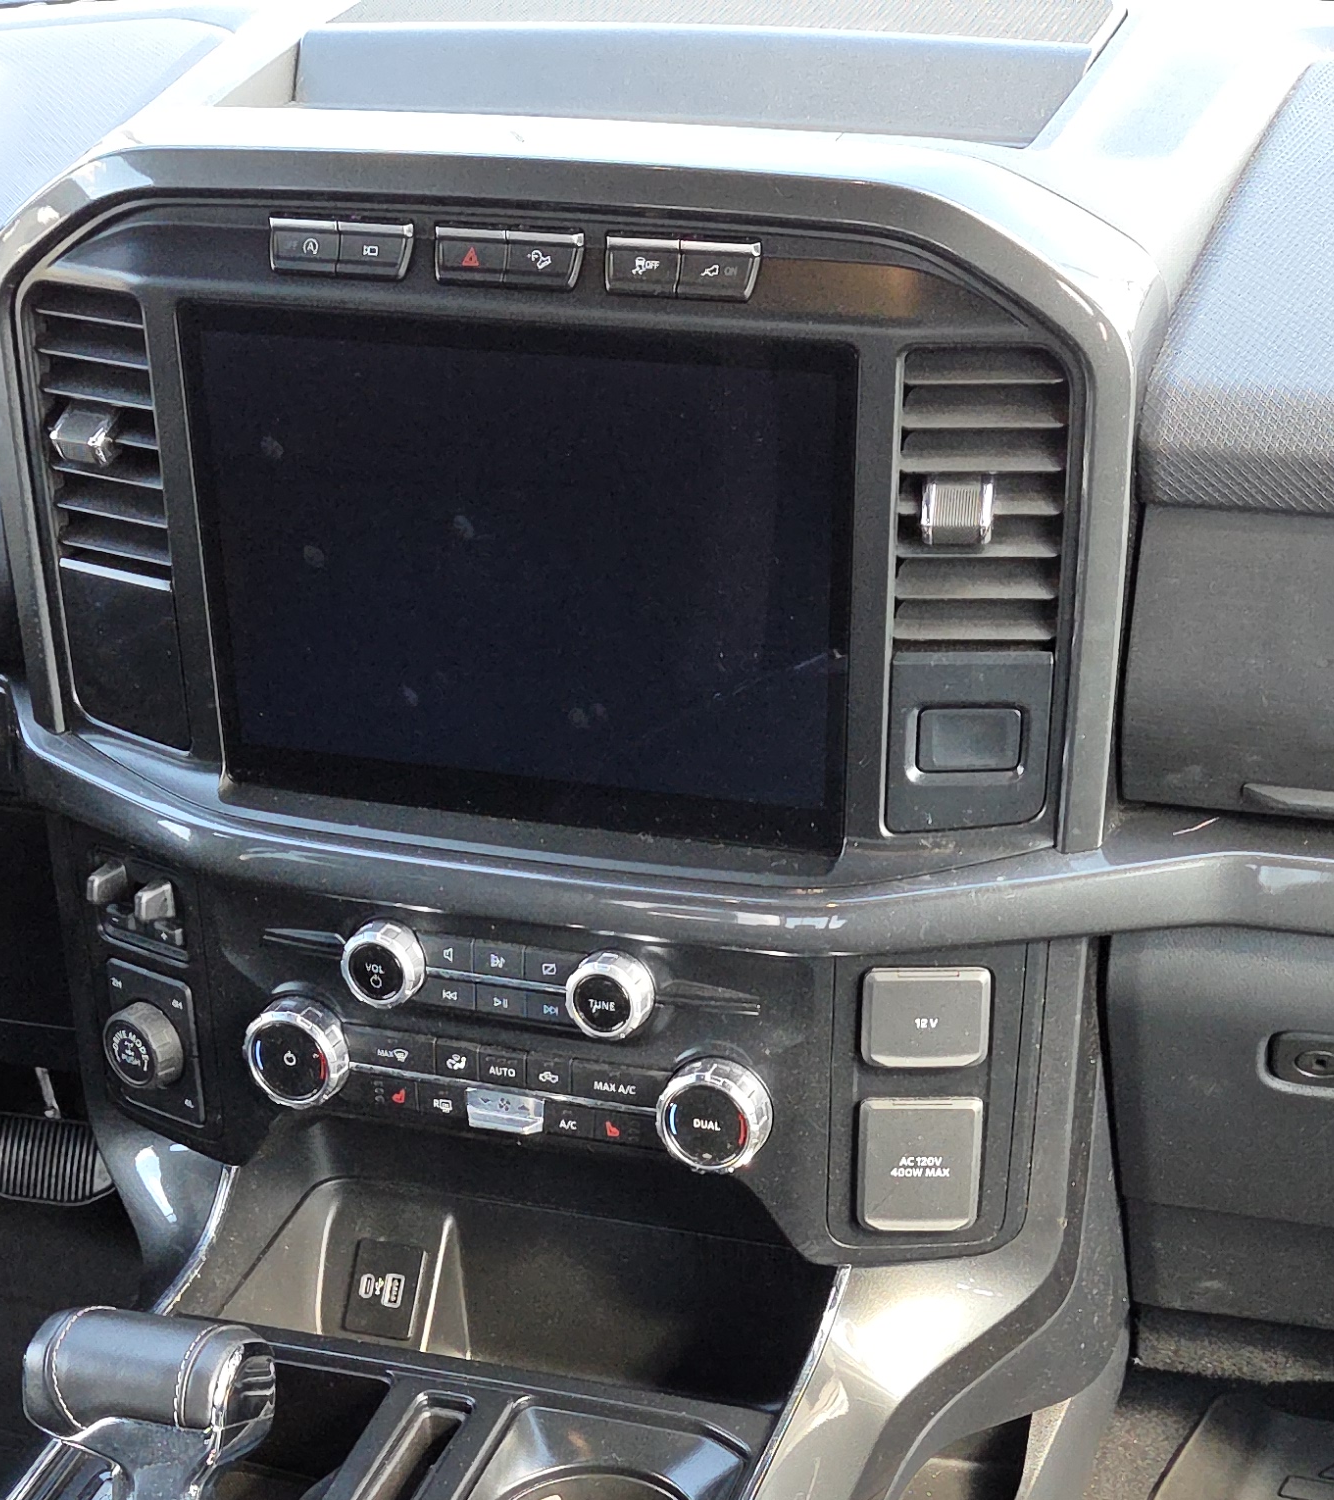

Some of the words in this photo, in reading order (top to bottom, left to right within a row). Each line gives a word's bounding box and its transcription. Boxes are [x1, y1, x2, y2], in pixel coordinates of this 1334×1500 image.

[645, 260, 660, 270] OFF
[724, 266, 738, 277] ON
[364, 962, 385, 974] VOL
[588, 999, 615, 1012] TUNE
[929, 1018, 938, 1028] V
[377, 1049, 394, 1058] MAX
[489, 1066, 516, 1078] AUTO
[593, 1081, 616, 1093] MAX
[618, 1083, 637, 1095] A/C
[559, 1118, 577, 1130] A/C
[693, 1118, 721, 1131] DUAL
[899, 1156, 914, 1167] AC
[915, 1156, 942, 1167] 120V
[890, 1167, 923, 1177] 400W
[925, 1167, 950, 1177] MAX
